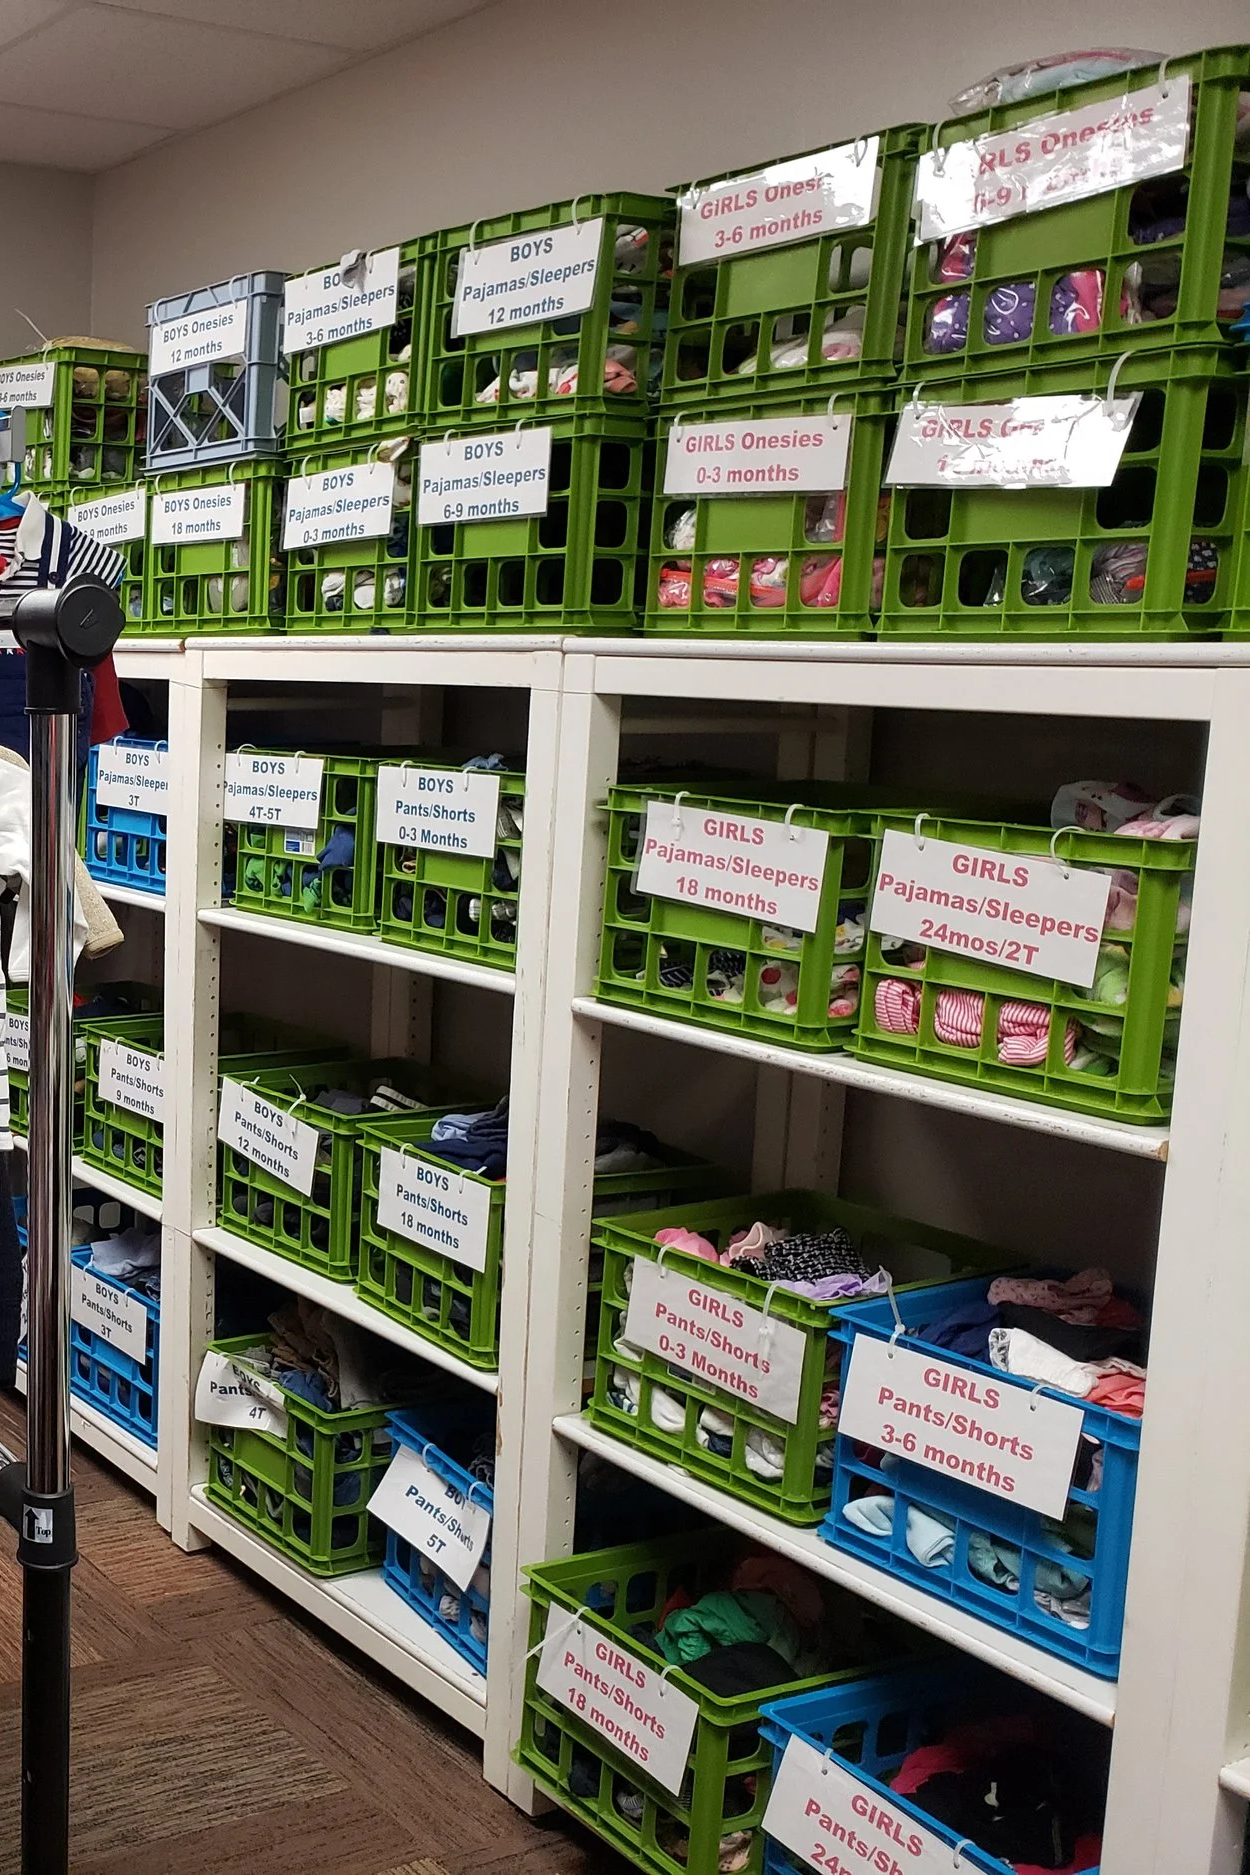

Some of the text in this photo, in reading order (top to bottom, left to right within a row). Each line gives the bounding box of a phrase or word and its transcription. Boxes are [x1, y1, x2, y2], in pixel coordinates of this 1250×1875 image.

[700, 190, 758, 220] GIRLS
[714, 208, 823, 249] 3-6 months
[510, 237, 553, 263] BOYS
[463, 259, 595, 303] Pajamas/Sleepers
[287, 285, 395, 326] Pajamas/Sleepers
[488, 295, 564, 325] 12 months
[164, 314, 234, 343] BOYS Onesies
[306, 317, 373, 346] 3-6 months
[171, 340, 223, 363] 12 months
[16, 370, 45, 382] Onesies
[9, 391, 37, 402] months
[464, 441, 504, 461] BOYS
[686, 430, 823, 453] GIRLS Onesies
[322, 473, 354, 491] BOYS
[423, 468, 546, 496] Pajamas/Sleepers
[696, 464, 799, 484] 0-3 months
[77, 500, 135, 523] BOYS Onesies
[164, 495, 232, 514] BOYS Onesies
[289, 495, 390, 524] Pajamas/Sleepers
[444, 498, 519, 519] 6-9 months
[97, 522, 128, 539] months
[171, 519, 221, 535] 18 months
[303, 522, 365, 543] 0-3 months
[126, 753, 150, 766] BOYS
[252, 761, 285, 775] BOYS
[99, 769, 168, 791] Pajamas/Sleeper
[224, 780, 318, 802] Pajamas/Sleepers
[418, 777, 454, 793] BOYS
[128, 795, 140, 806] 3T
[249, 806, 281, 820] 4T-5T
[395, 800, 476, 822] Pants/Shorts
[399, 826, 468, 848] 0-3 Months
[703, 818, 765, 845] GIRLS
[645, 838, 819, 891] Pajamas/Sleepers
[952, 854, 1029, 887] GIRLS
[676, 876, 778, 915] 18 months
[878, 873, 1099, 943] Pajamas/Sleepers
[919, 918, 1040, 965] 24mos/2T
[9, 1018, 29, 1031] BOYS
[127, 1054, 150, 1071] BOYS
[111, 1068, 164, 1097] Pants/Shorts
[116, 1090, 154, 1114] 9 months
[254, 1101, 283, 1127] BOYS
[235, 1111, 299, 1160] Pants/Shorts
[238, 1136, 290, 1178] 12 months
[417, 1166, 449, 1191] BOYS
[396, 1184, 468, 1226] Pants/Shorts
[401, 1211, 459, 1249] 18 months
[96, 1283, 119, 1304] BOYS
[82, 1293, 132, 1333] Pants/Shorts
[688, 1289, 744, 1328] GIRLS
[101, 1325, 111, 1338] 3T
[655, 1302, 771, 1374] Pants/Shorts
[659, 1335, 759, 1399] 0-3 Months
[210, 1381, 253, 1397] Pants
[923, 1368, 1000, 1409] GIRLS
[249, 1407, 266, 1419] 4T
[878, 1387, 1033, 1461] Pants/Shorts
[881, 1424, 1015, 1493] 3-6 months
[36, 1526, 51, 1537] Top
[427, 1534, 447, 1553] 5T
[595, 1643, 646, 1689] GIRLS
[564, 1651, 665, 1740] Pants/Shorts
[568, 1687, 649, 1762] 18 months
[804, 1798, 903, 1875] Pants/Sh
[851, 1794, 923, 1857] GIRLS
